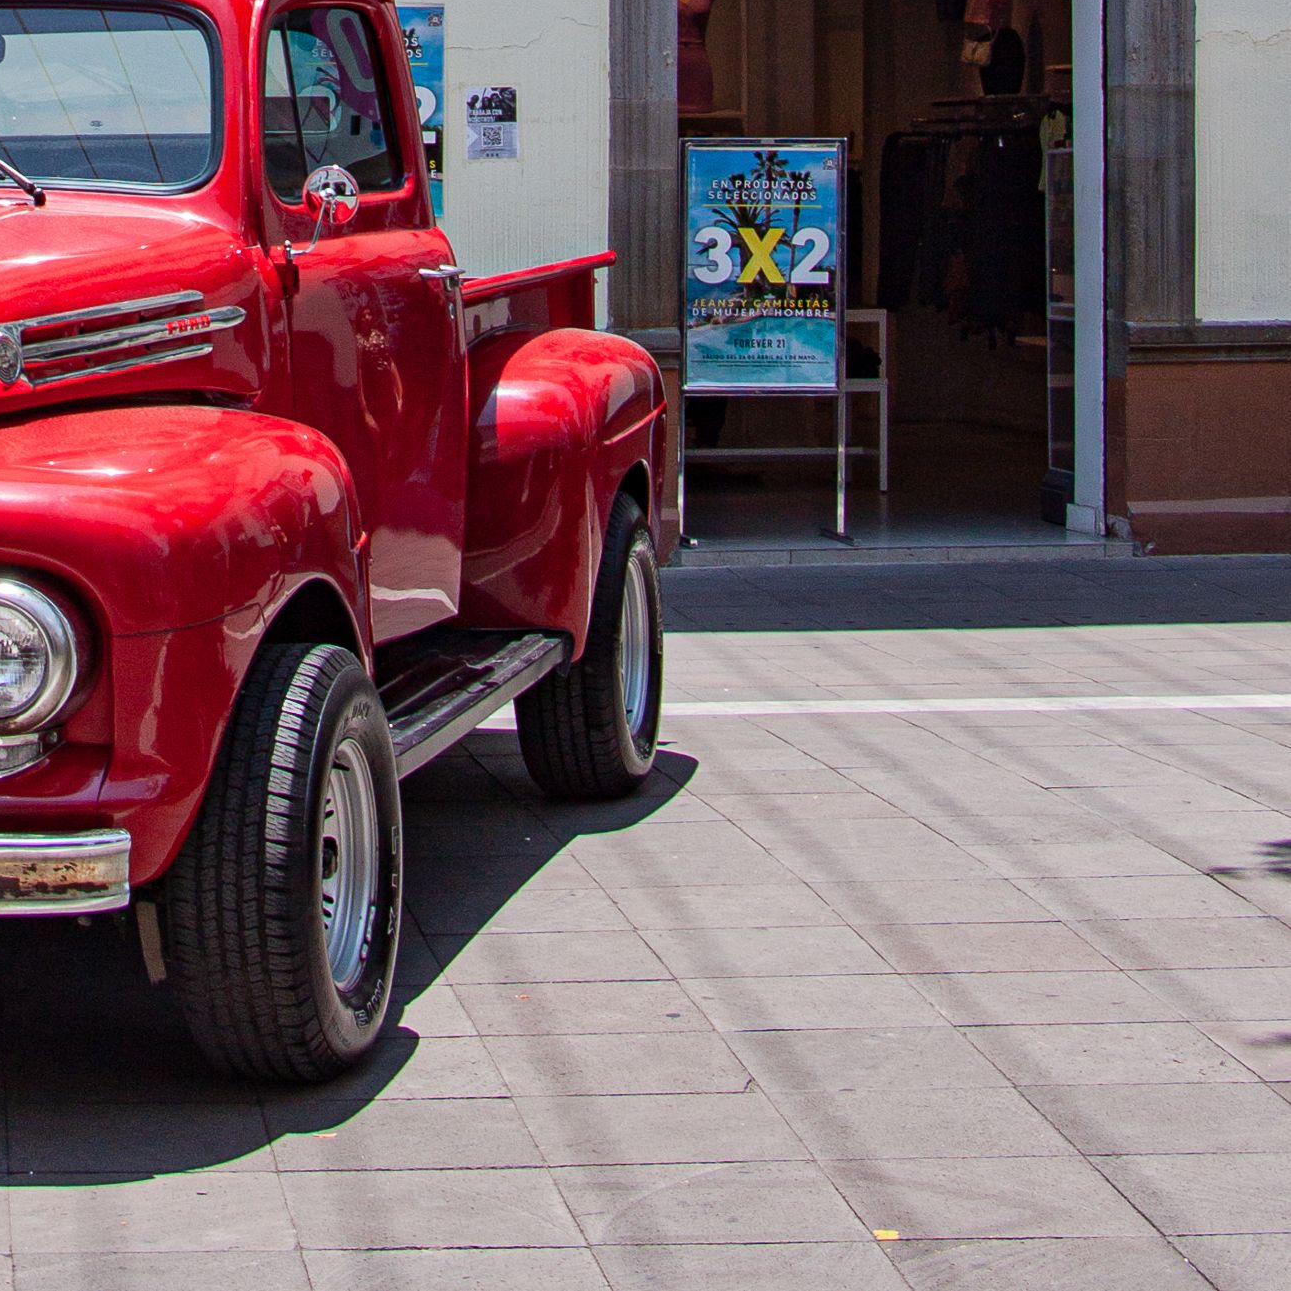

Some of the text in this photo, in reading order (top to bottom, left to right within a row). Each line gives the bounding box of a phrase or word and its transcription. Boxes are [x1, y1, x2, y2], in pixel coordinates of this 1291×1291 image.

[712, 179, 814, 190] EN PRODUCTOS
[707, 191, 817, 201] SELECCIONADOS
[693, 226, 830, 284] 3X2
[692, 298, 830, 308] JEANS Y CAMISETAS
[692, 308, 830, 318] DE MUJER Y HOMBRE
[165, 314, 210, 335] FORD
[734, 338, 786, 349] FOREVER 21
